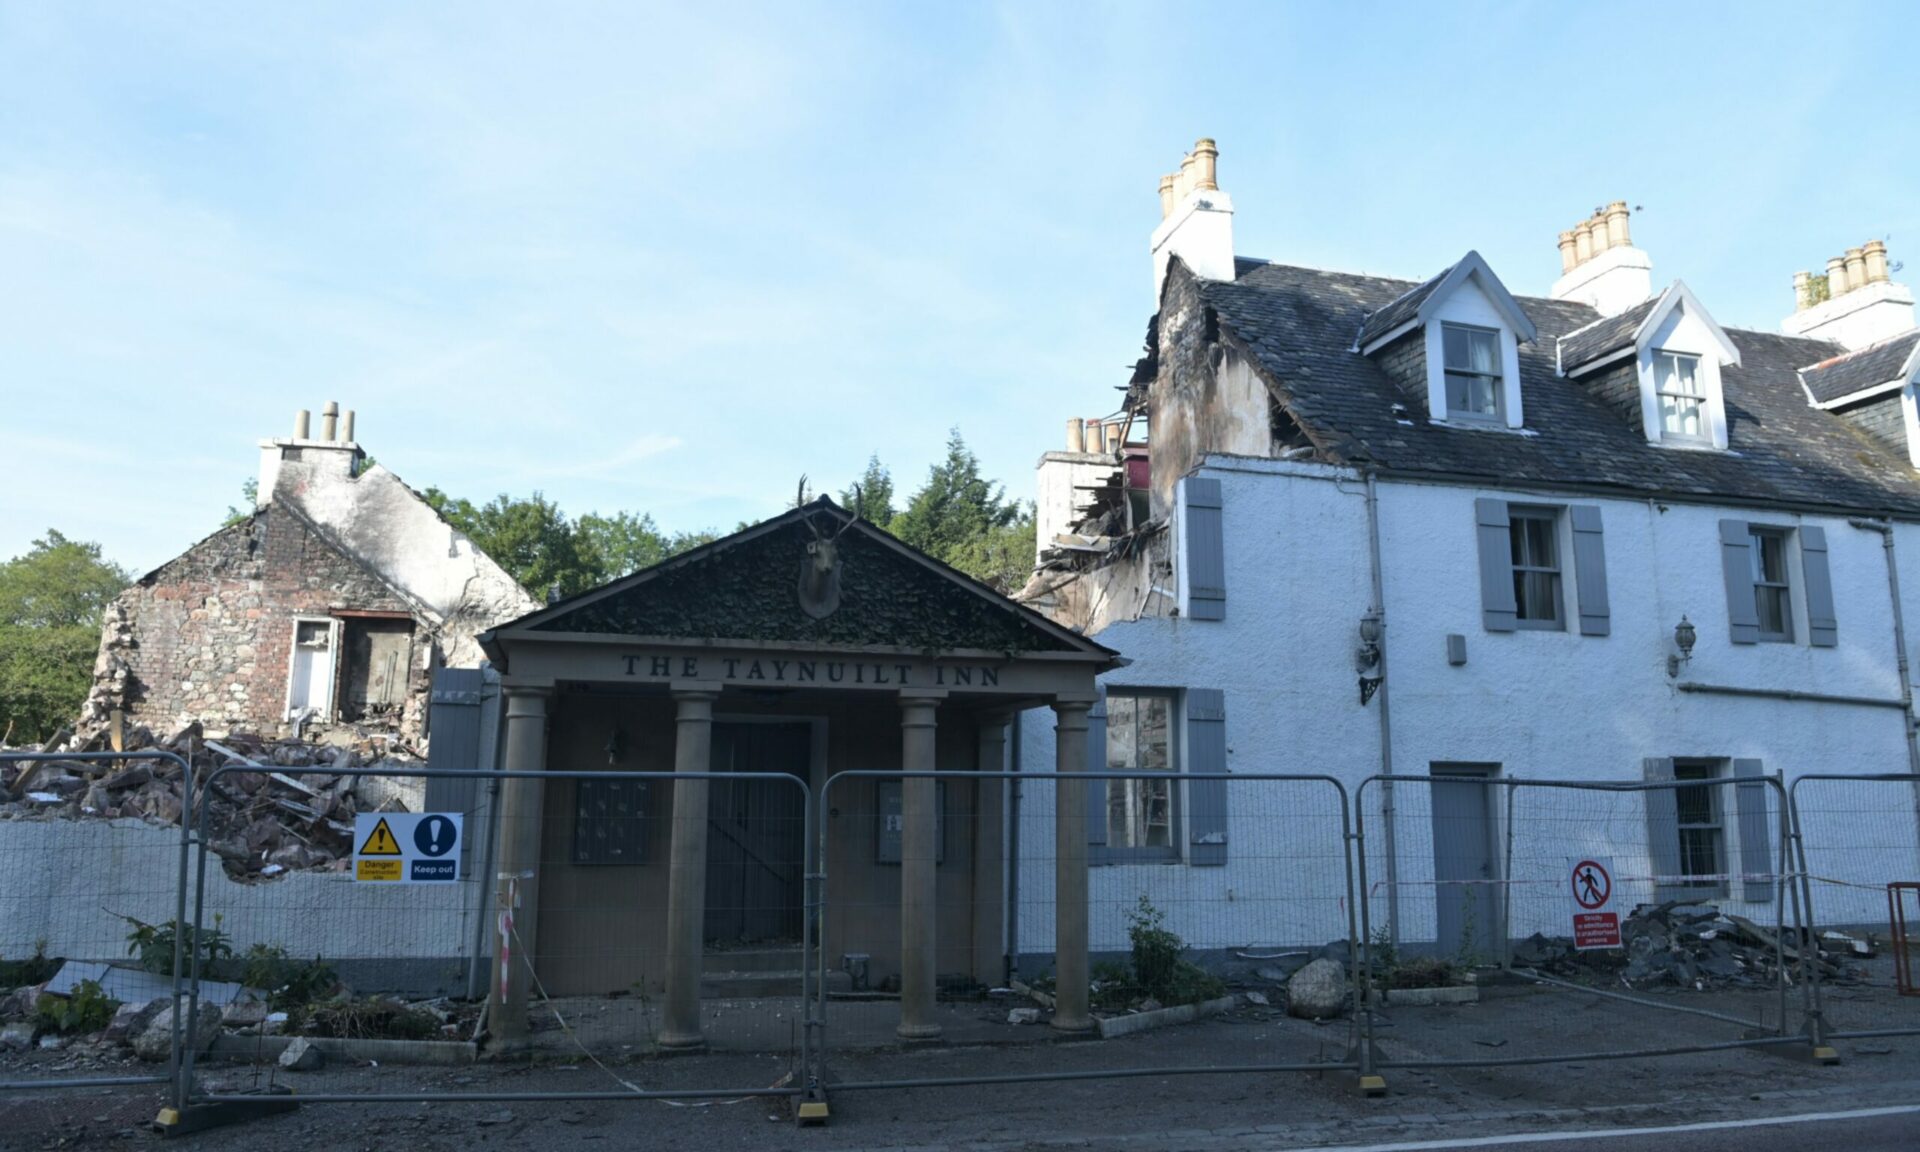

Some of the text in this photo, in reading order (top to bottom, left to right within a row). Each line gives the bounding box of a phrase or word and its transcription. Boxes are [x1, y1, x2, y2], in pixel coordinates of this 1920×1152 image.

[622, 655, 1000, 687] THE TAYNUILT INN
[364, 860, 394, 869] Danger
[414, 865, 453, 874] Keep out
